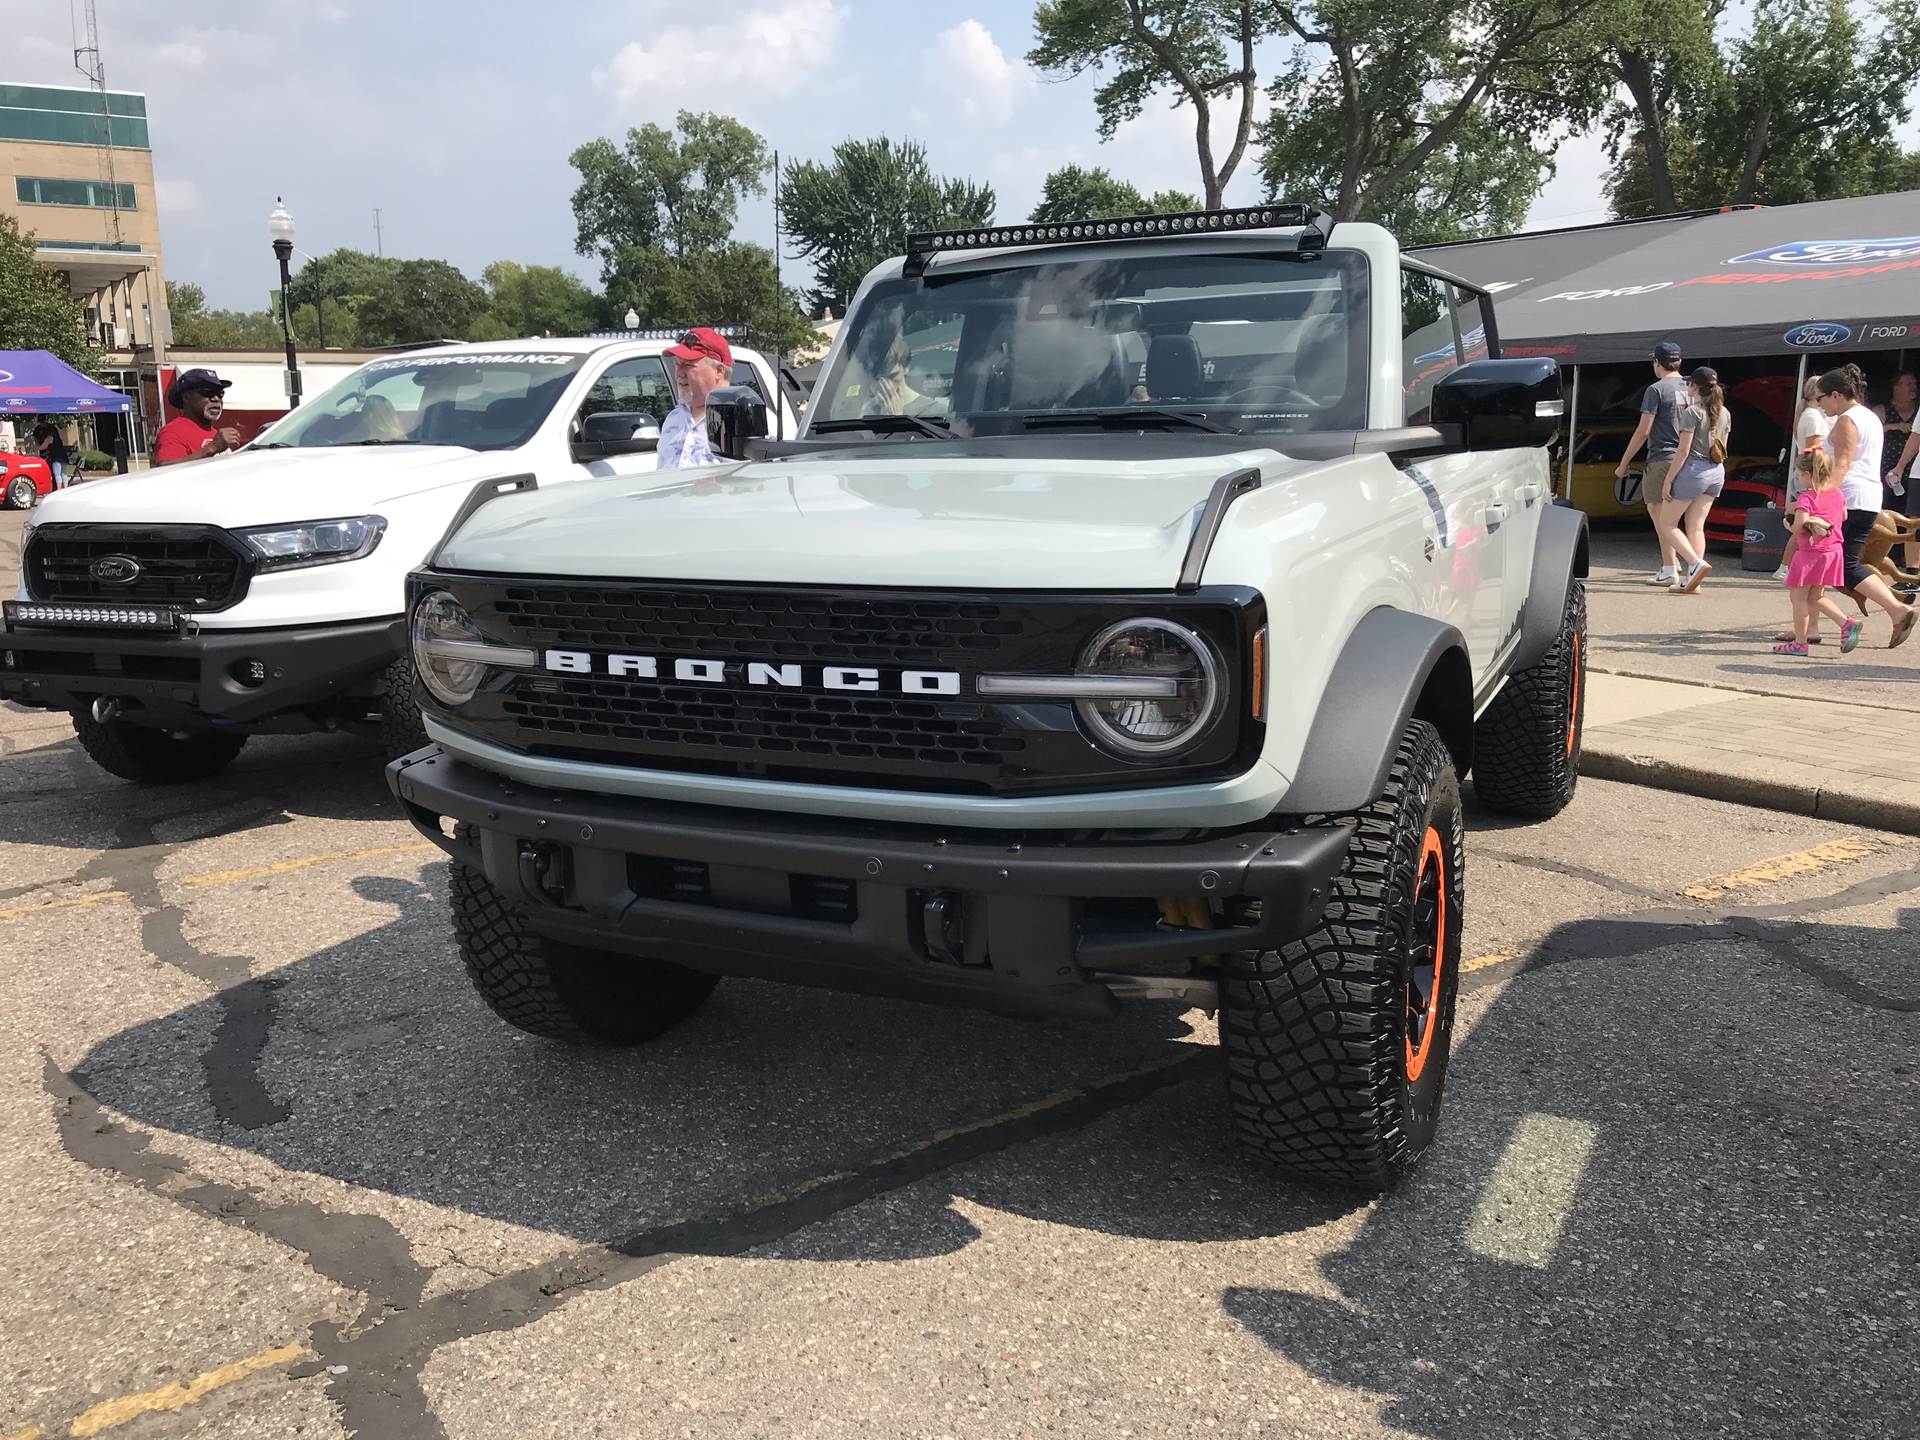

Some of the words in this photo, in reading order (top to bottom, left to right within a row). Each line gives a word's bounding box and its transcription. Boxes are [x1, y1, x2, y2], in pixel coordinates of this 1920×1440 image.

[1536, 281, 1674, 302] FORD
[1796, 327, 1838, 345] Ford
[1870, 326, 1907, 337] FORD
[406, 354, 575, 368] PERFORMANCE
[1620, 473, 1643, 501] 17
[545, 649, 961, 696] BRONCO
